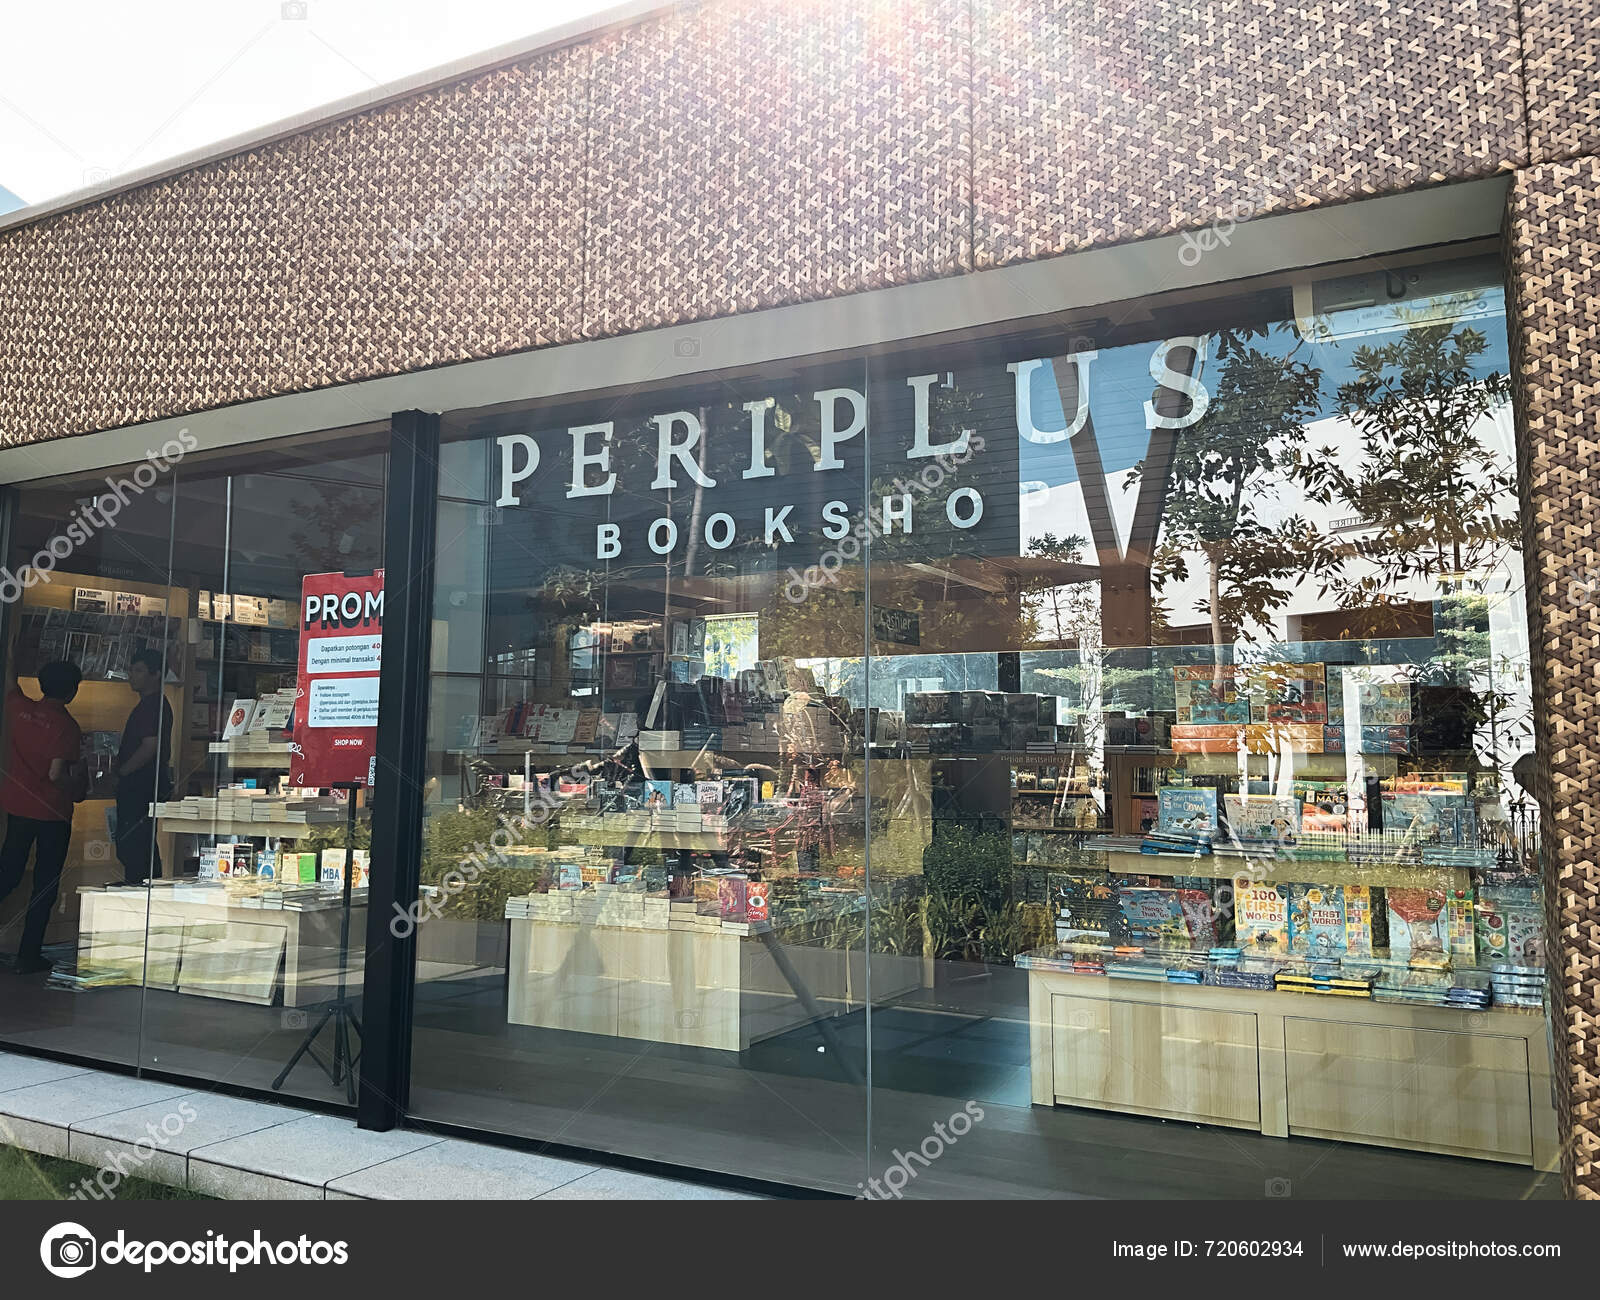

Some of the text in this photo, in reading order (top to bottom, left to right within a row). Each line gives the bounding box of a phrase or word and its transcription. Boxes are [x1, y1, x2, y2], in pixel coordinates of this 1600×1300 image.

[495, 334, 1209, 508] PERIPLUS
[880, 610, 911, 631] Cashier
[321, 645, 344, 653] Dapatkan
[345, 644, 370, 652] potongan
[352, 655, 375, 663] transaksi
[1316, 795, 1346, 804] MARS
[322, 868, 340, 880] MBA
[1251, 889, 1277, 901] 100
[1246, 900, 1285, 913] FIRST
[1245, 911, 1283, 922] WORDS
[1312, 909, 1341, 918] FIRST
[1311, 917, 1342, 926] WORDS
